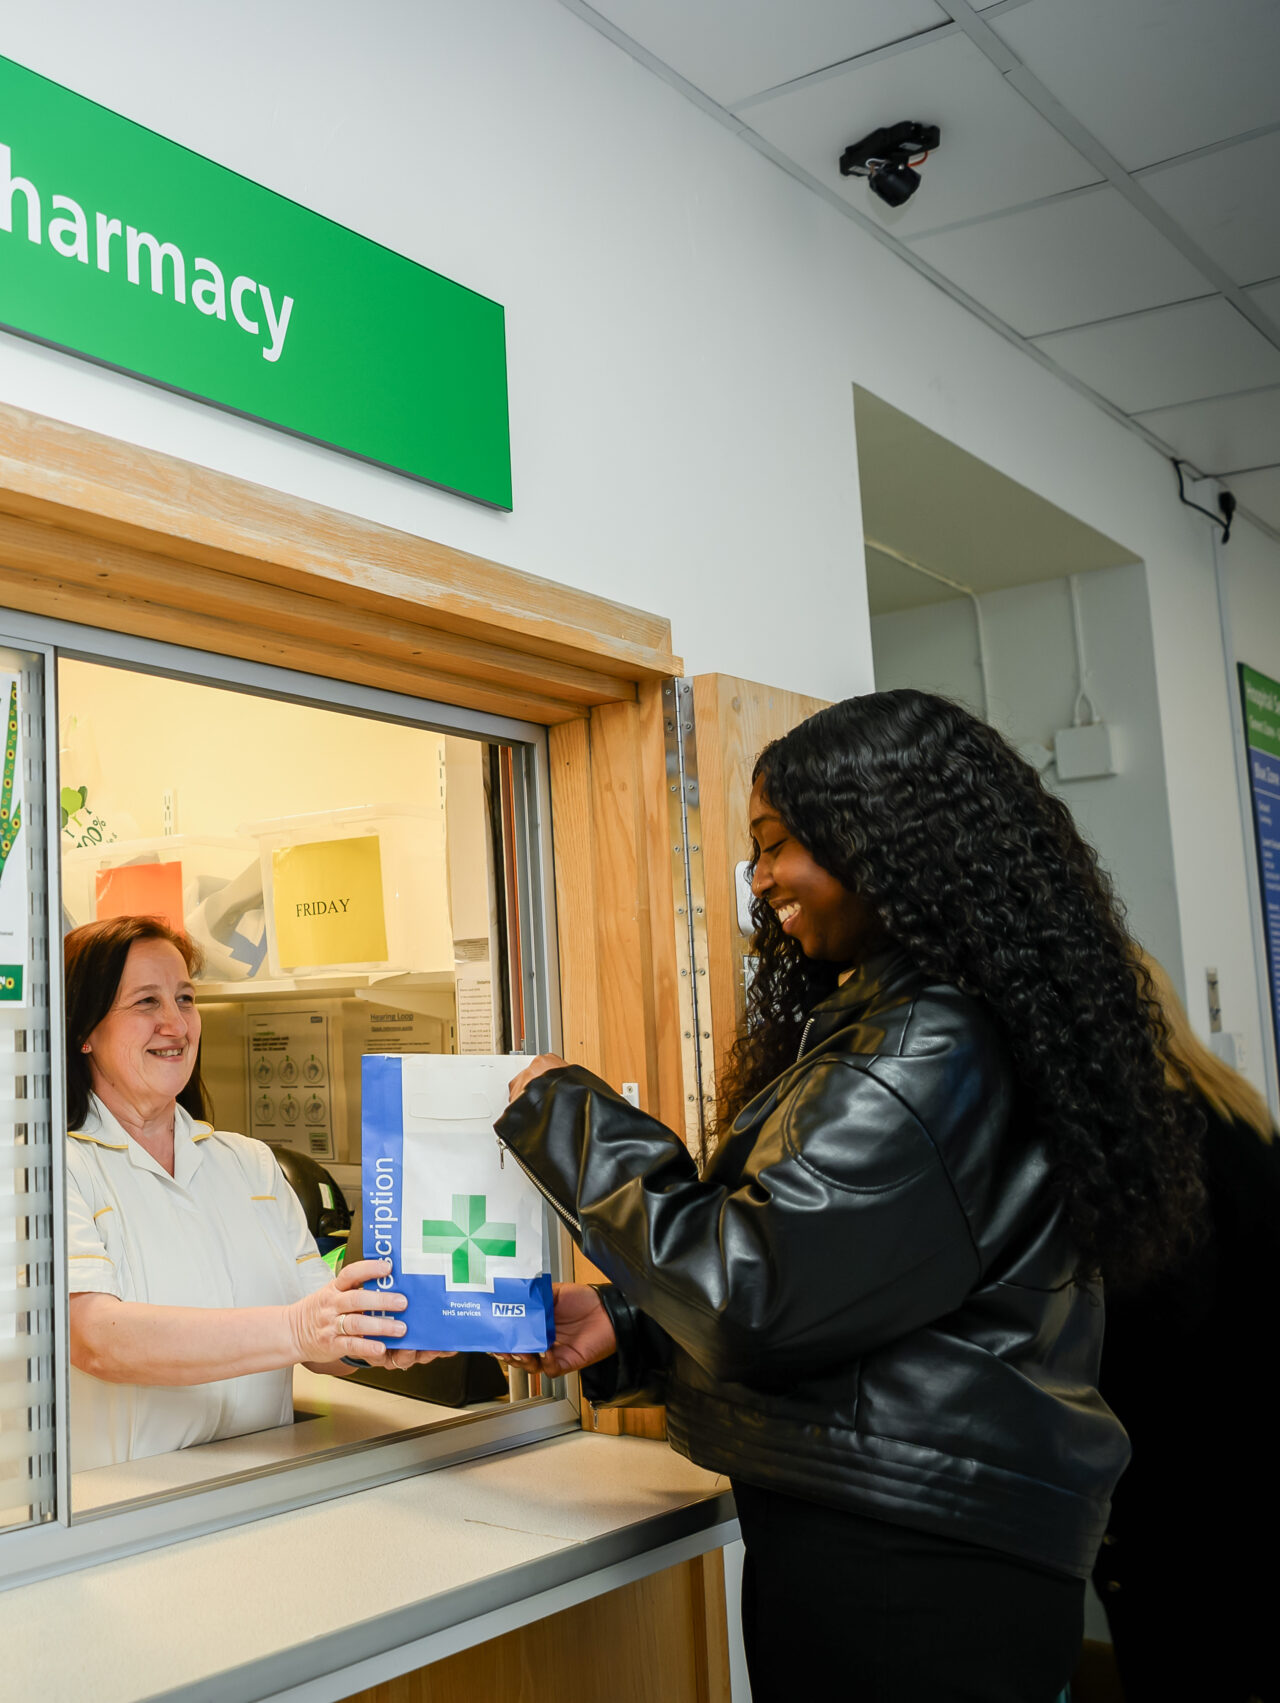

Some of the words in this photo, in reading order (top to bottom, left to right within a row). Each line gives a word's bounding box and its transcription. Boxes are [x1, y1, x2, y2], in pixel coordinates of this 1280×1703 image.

[296, 898, 350, 917] FRIDAY
[450, 1301, 481, 1310] Providing
[494, 1304, 524, 1315] NHS
[442, 1309, 456, 1317] NHS
